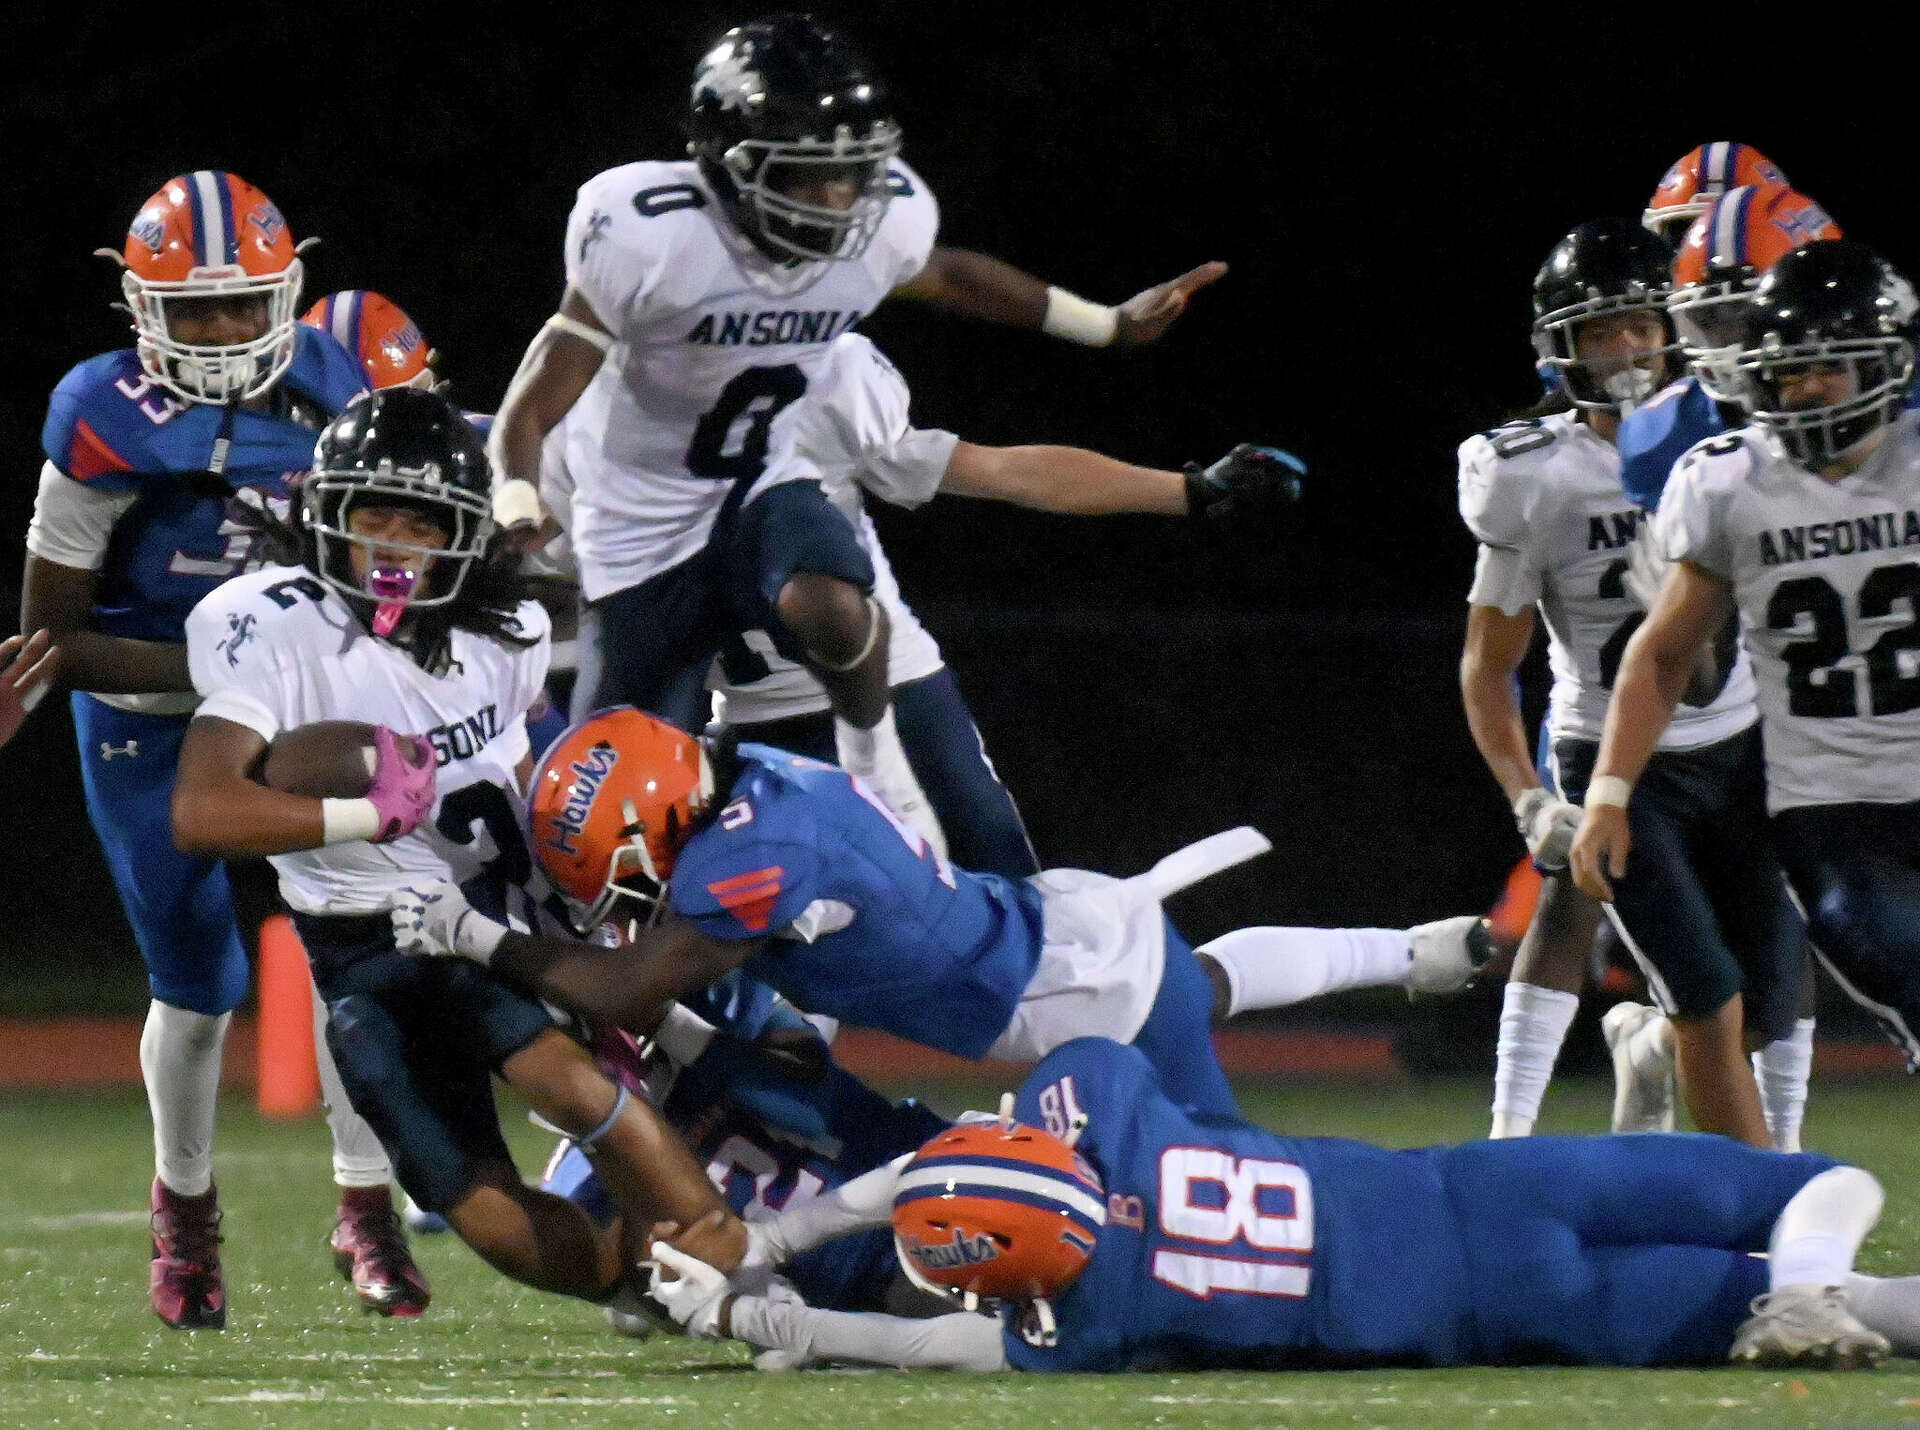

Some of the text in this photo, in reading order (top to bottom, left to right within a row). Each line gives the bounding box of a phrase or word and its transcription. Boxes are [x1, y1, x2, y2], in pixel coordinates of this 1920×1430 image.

[1766, 562, 1920, 718] 22
[426, 703, 504, 768] SONI
[551, 740, 619, 856] Hawks
[1151, 1145, 1316, 1301] 18
